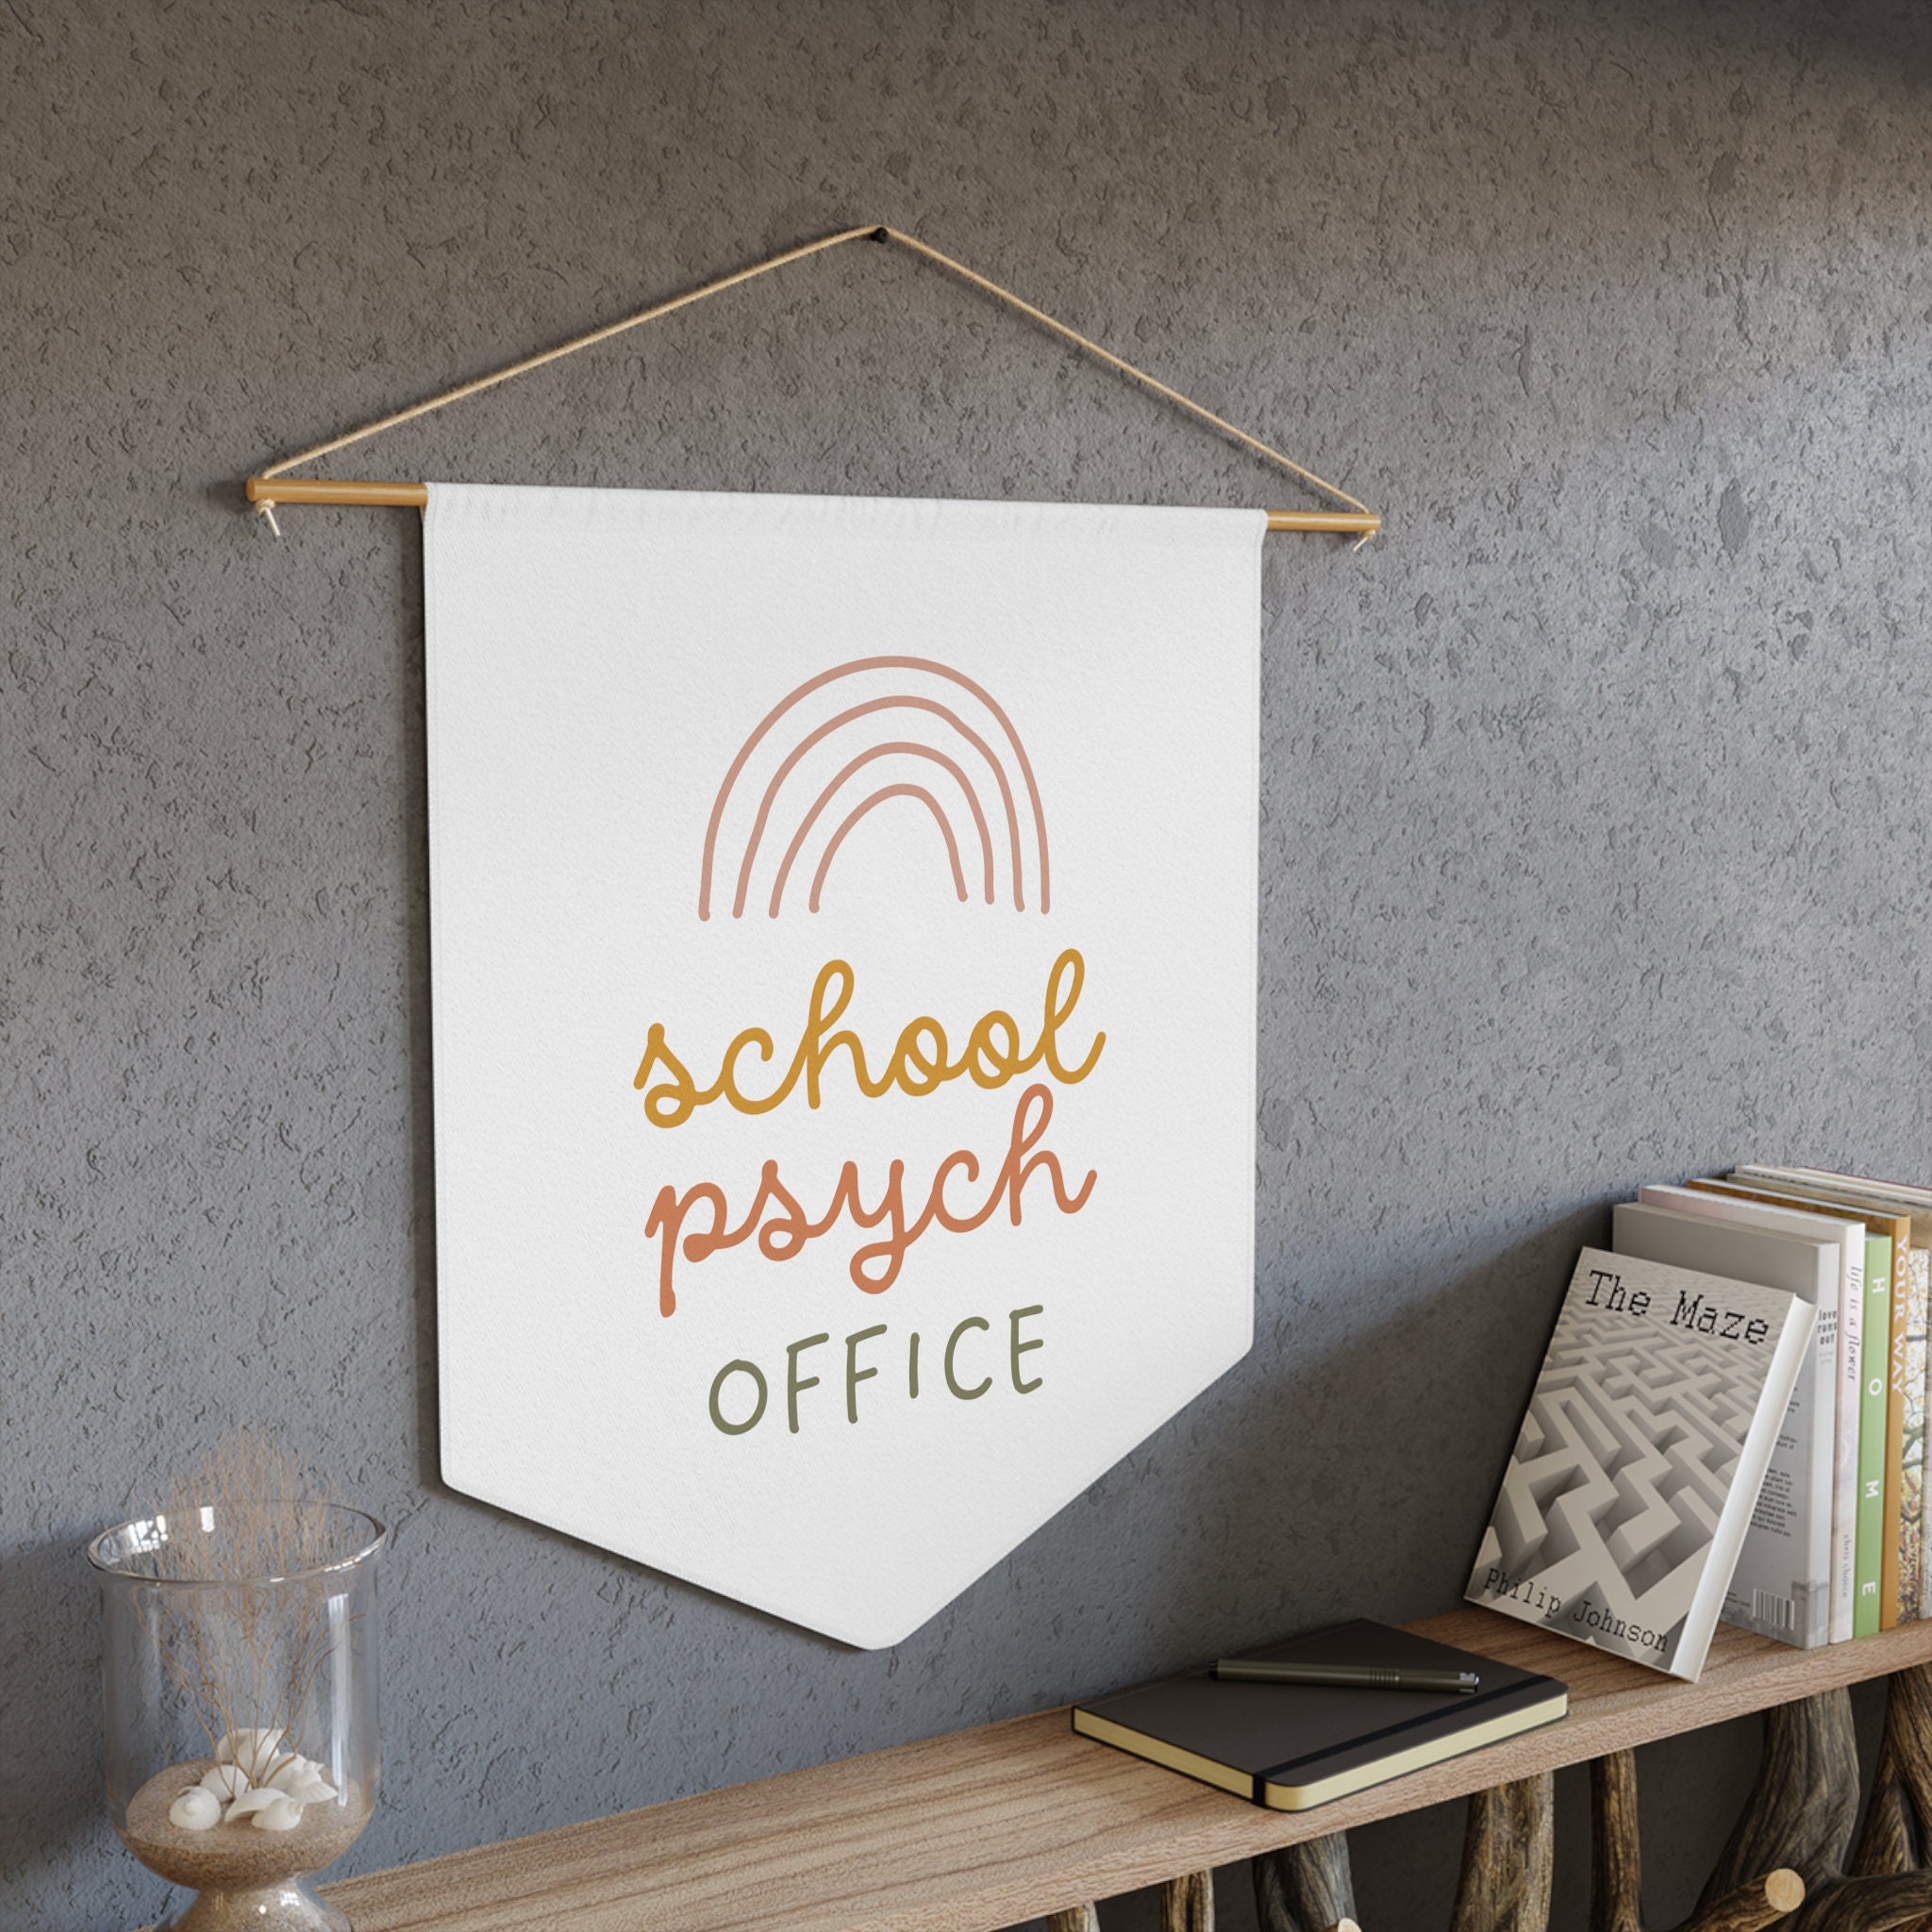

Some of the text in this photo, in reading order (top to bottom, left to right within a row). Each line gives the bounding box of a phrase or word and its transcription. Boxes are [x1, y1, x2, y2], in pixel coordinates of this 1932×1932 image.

[633, 948, 1107, 1128] school
[644, 1084, 1097, 1317] psych
[708, 1305, 1044, 1435] OFFICE
[1586, 1270, 1770, 1344] The Maze
[1892, 1237, 1907, 1393] YOUR WAY
[1484, 1568, 1669, 1652] Philip Johnson
